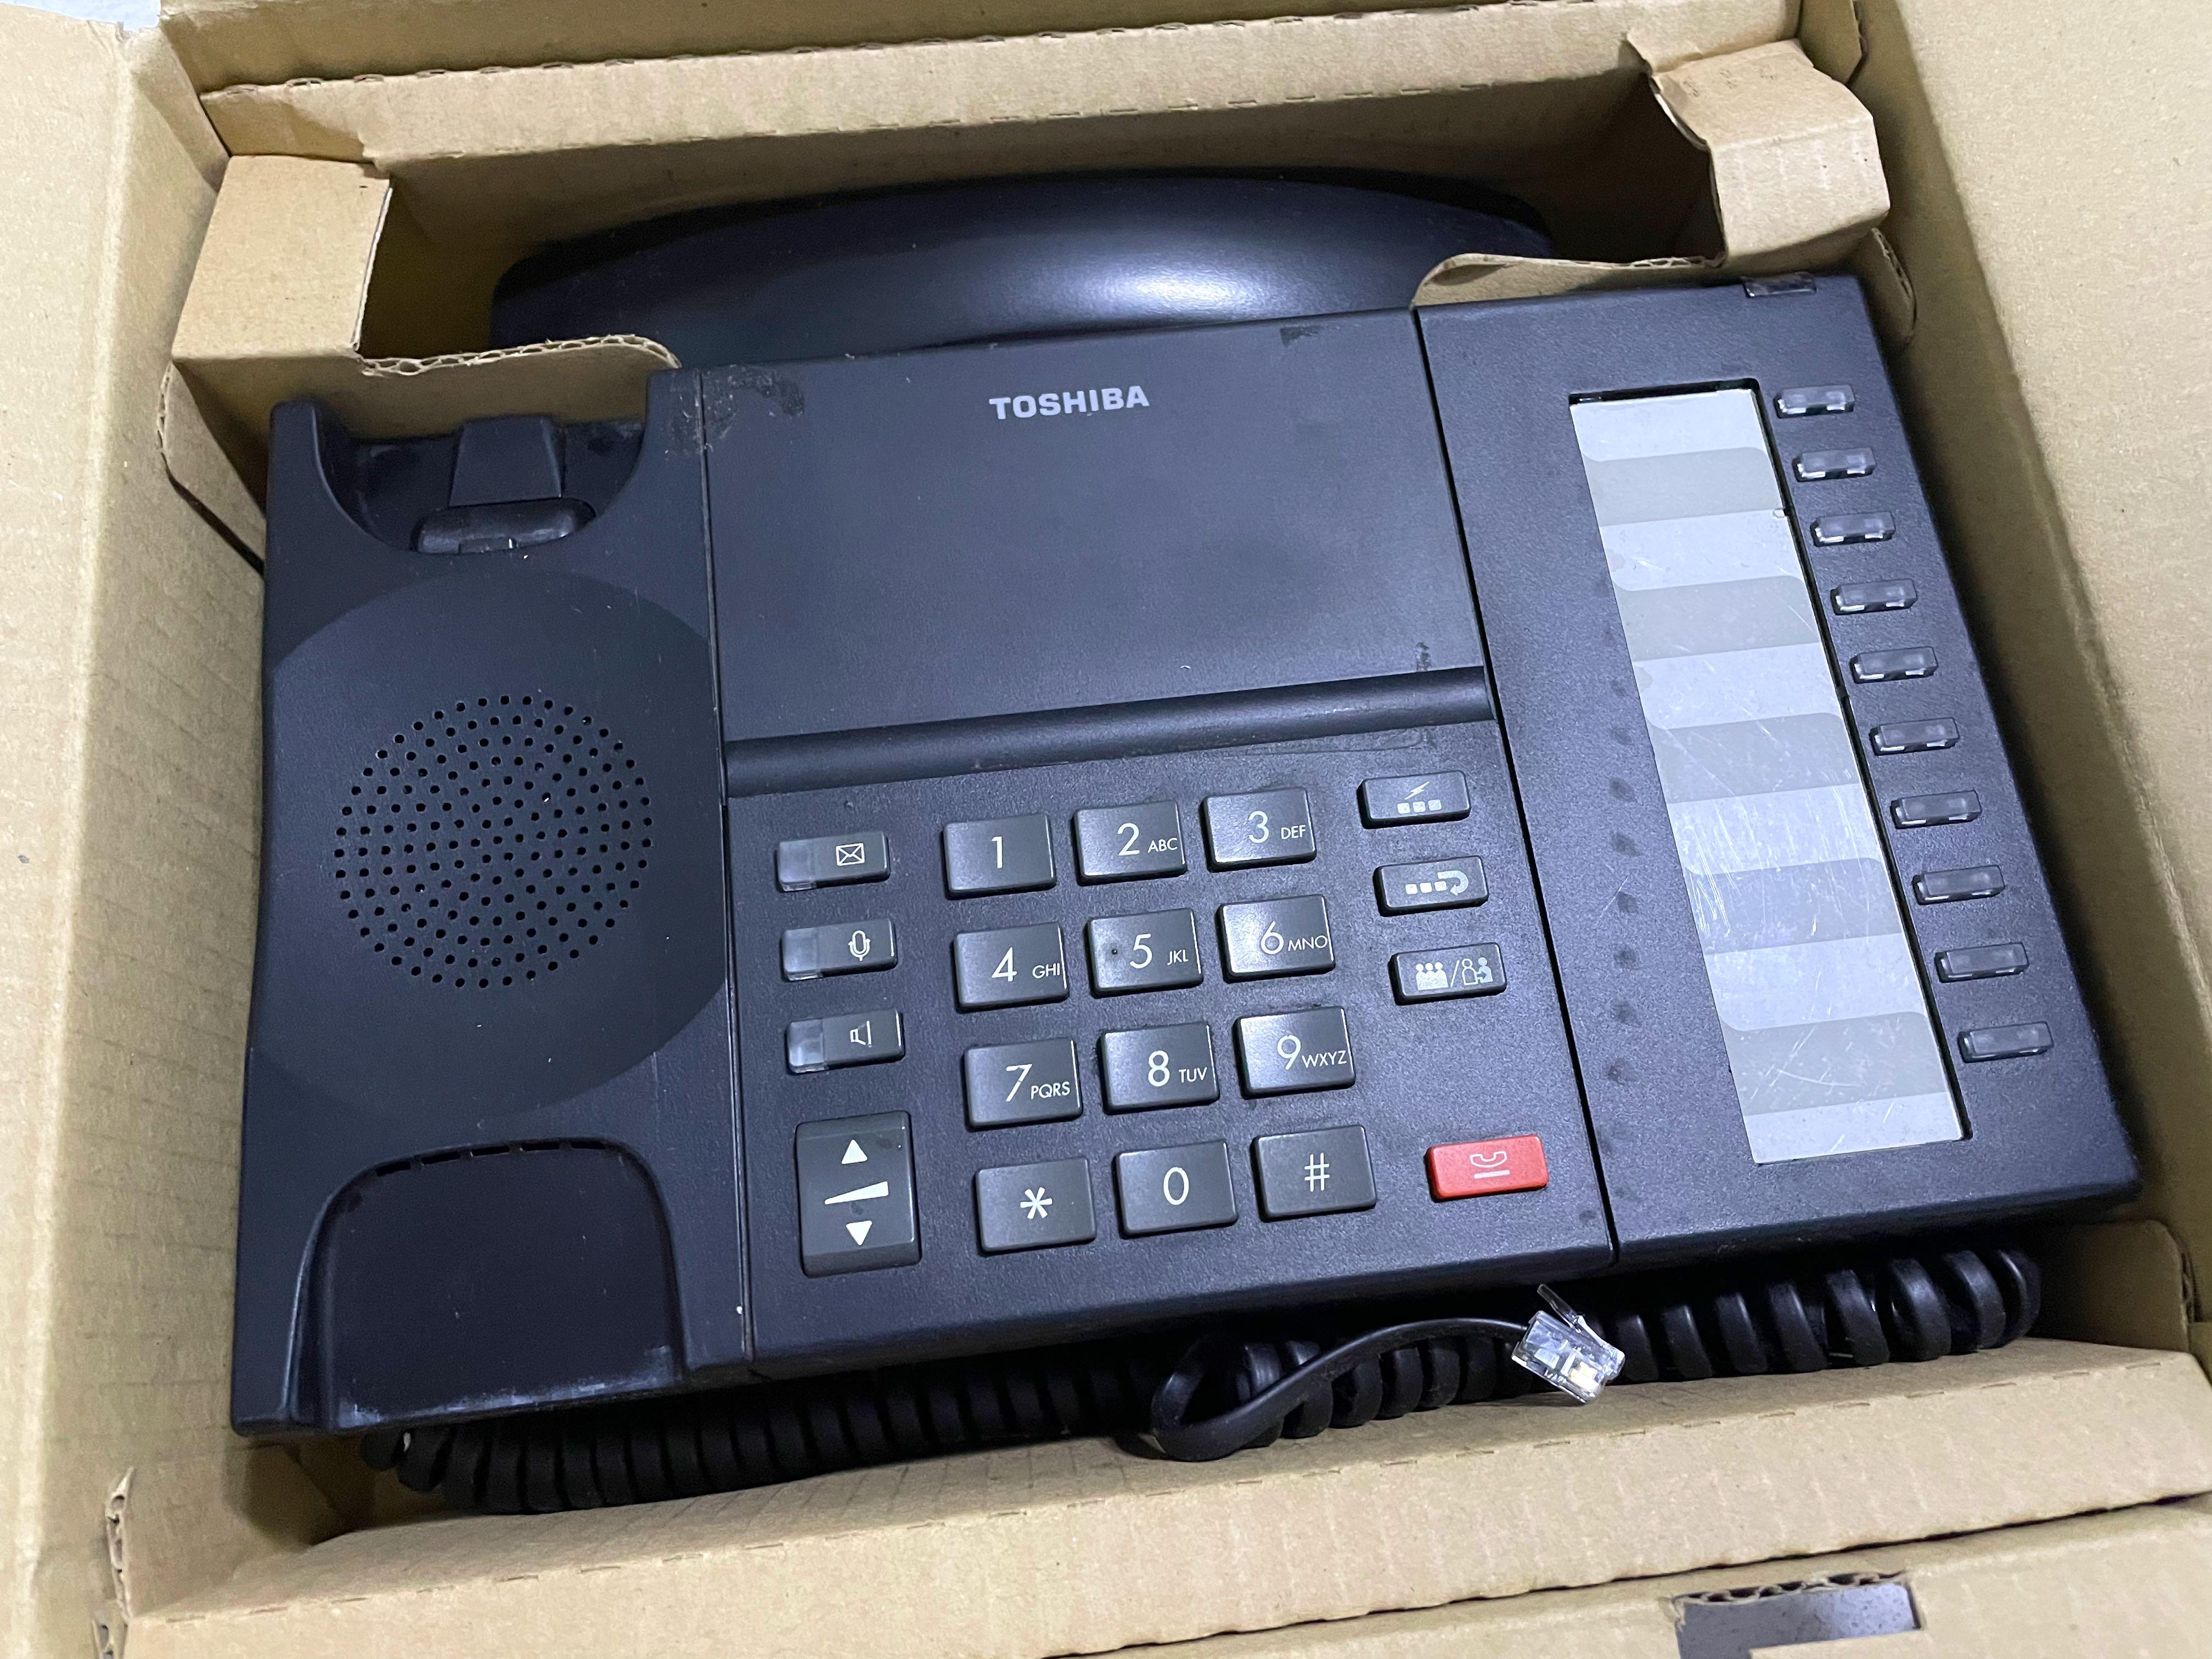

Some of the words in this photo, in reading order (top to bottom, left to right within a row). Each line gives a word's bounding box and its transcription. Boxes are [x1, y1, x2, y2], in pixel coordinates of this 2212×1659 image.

[989, 386, 1150, 420] TOSHIBA
[1117, 822, 1140, 856] 2
[1147, 837, 1178, 853] ABC
[1248, 811, 1269, 843] 3
[1281, 825, 1306, 839] DEF
[992, 836, 1003, 868] 1
[1129, 933, 1152, 969] 5
[1167, 949, 1189, 966] JKL
[1259, 921, 1285, 956] 6
[1288, 932, 1329, 951] MNO
[991, 947, 1017, 982] 4
[1032, 963, 1060, 979] GHI
[1148, 1050, 1170, 1087] 8
[1178, 1066, 1207, 1083] TUV
[1276, 1034, 1302, 1071] 9
[1302, 1050, 1347, 1068] WXYZ
[1005, 1064, 1032, 1102] 7
[1031, 1081, 1071, 1099] PQRS
[1163, 1167, 1189, 1205] 0
